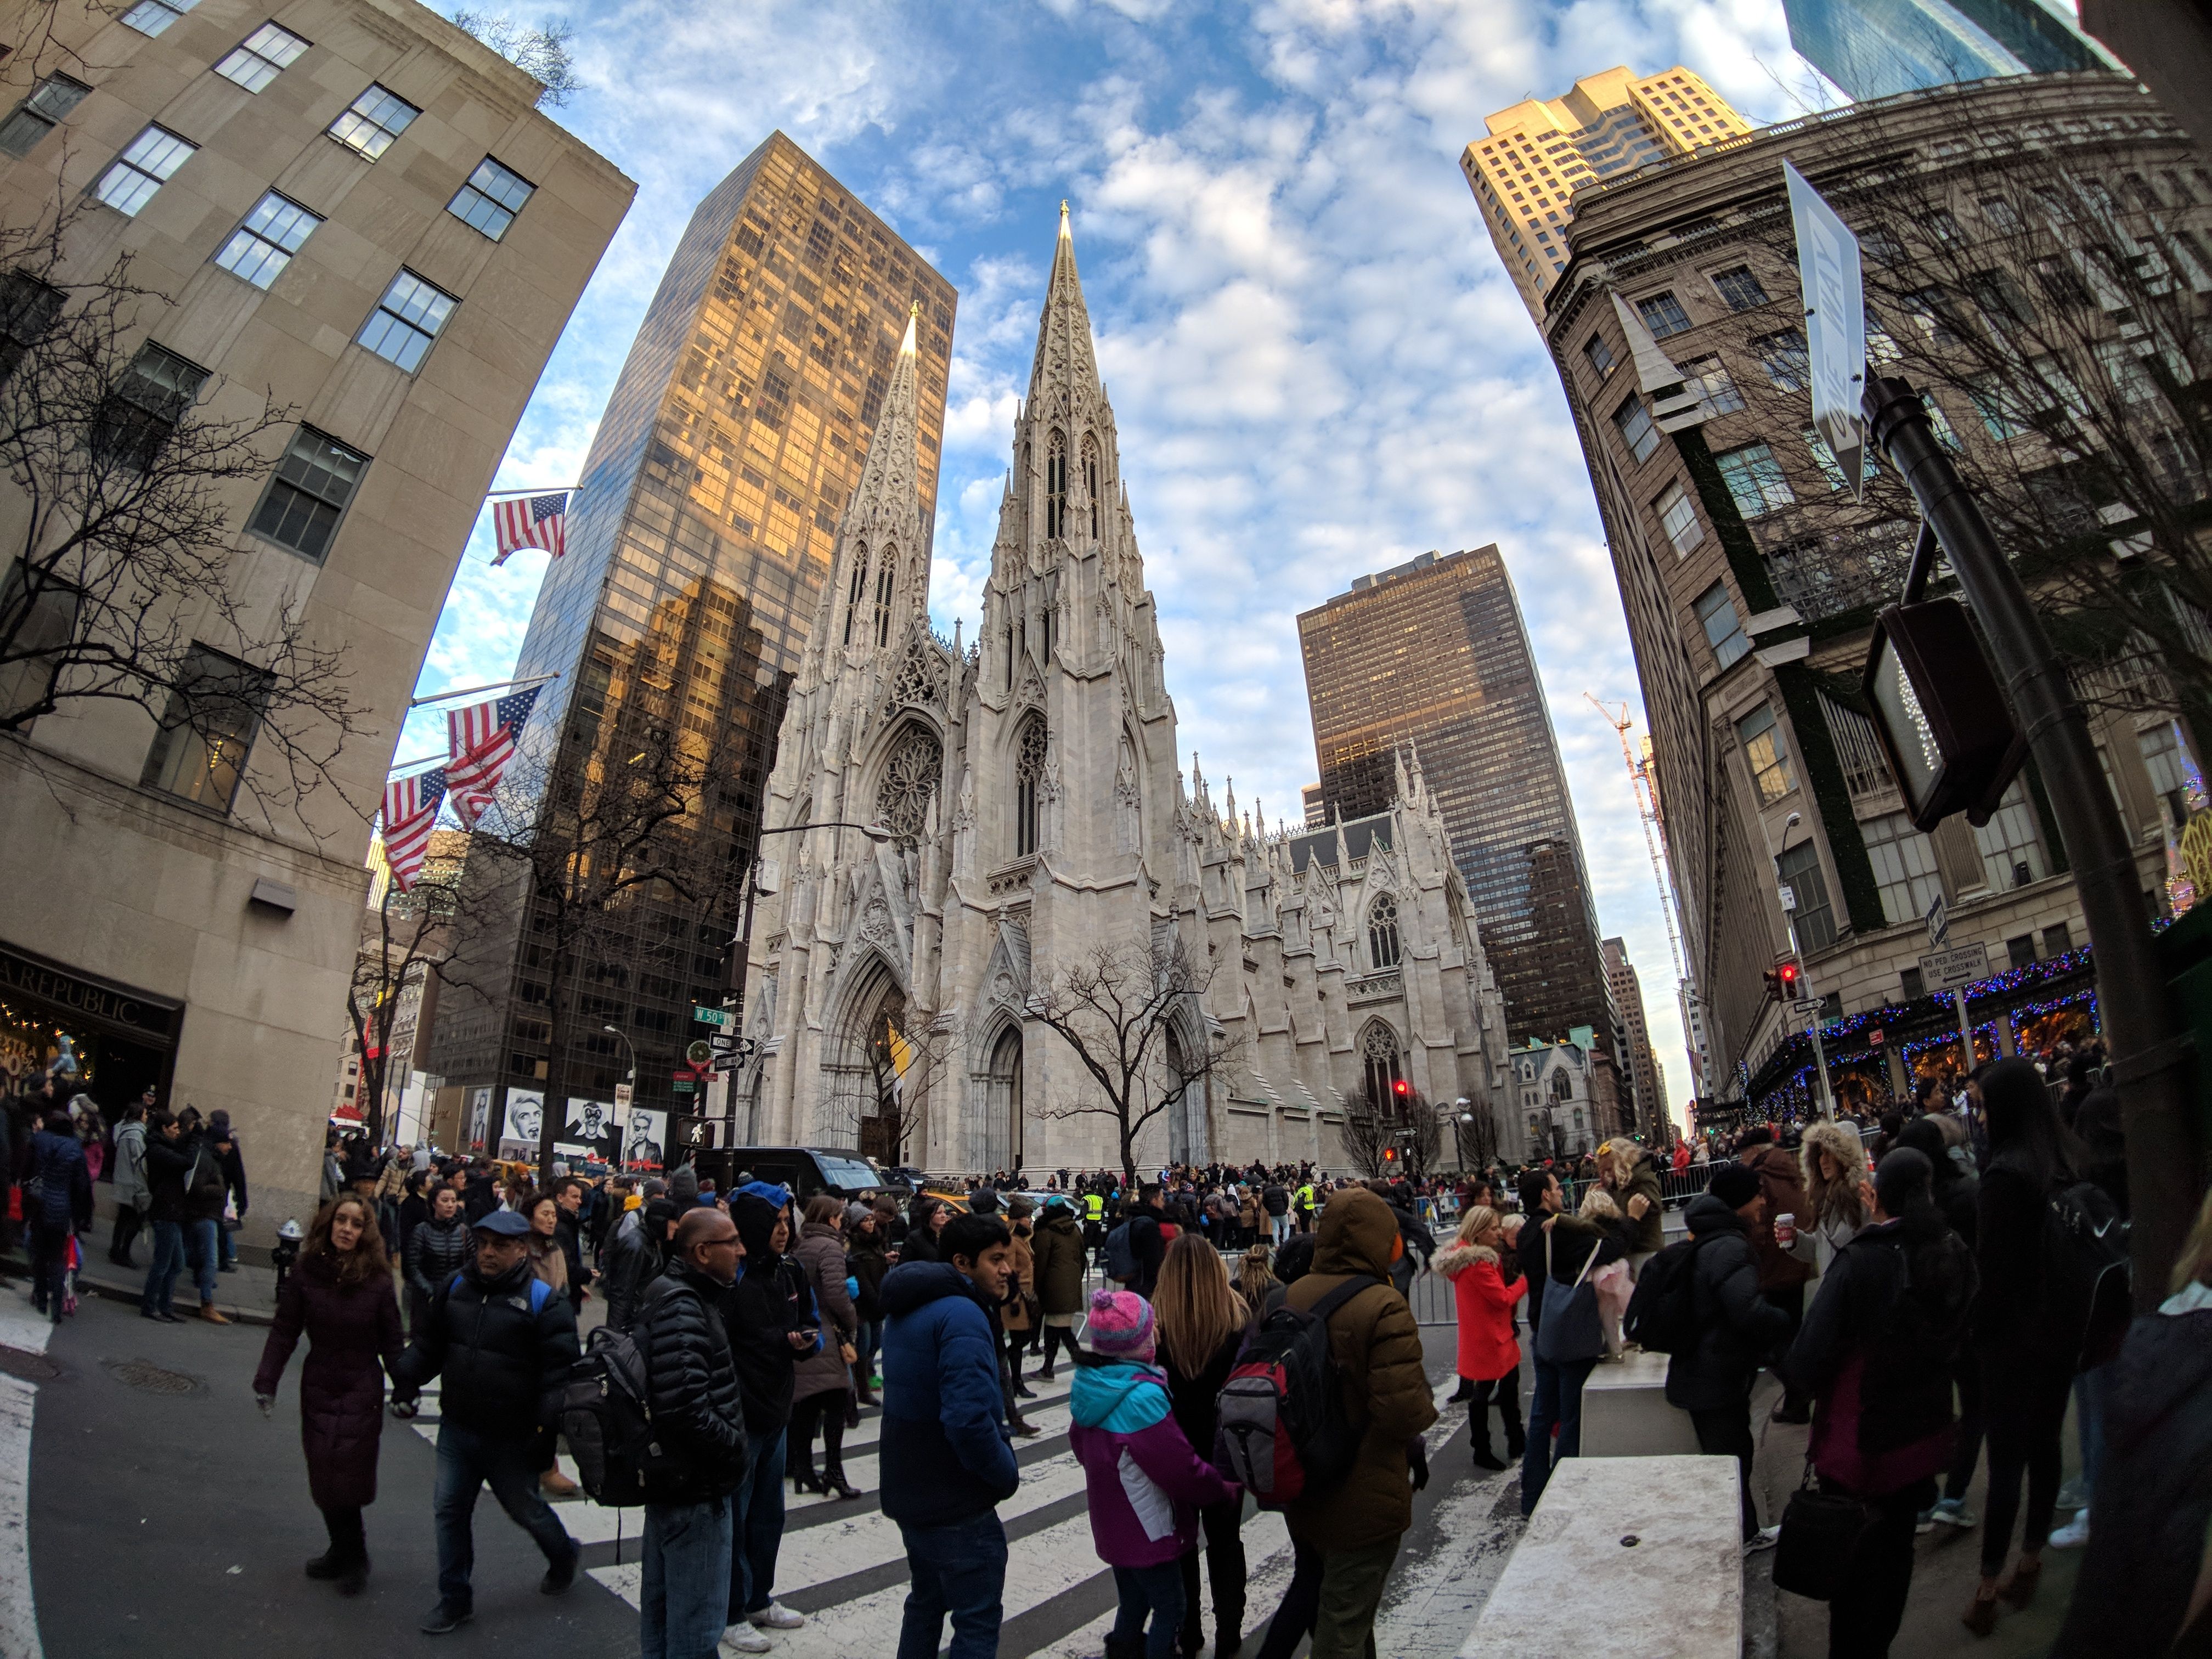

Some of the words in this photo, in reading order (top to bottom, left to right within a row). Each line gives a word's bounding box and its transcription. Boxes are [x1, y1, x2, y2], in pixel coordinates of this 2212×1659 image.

[1812, 225, 1845, 339] WAY
[1825, 354, 1848, 439] ONE
[1935, 957, 1948, 966] PED
[1950, 947, 1983, 961] CROSSING
[1928, 969, 1941, 978] USE
[1944, 959, 1982, 975] CROSSWALK
[20, 966, 139, 1024] REPUBLIC
[697, 1008, 704, 1020] W
[707, 1011, 718, 1022] 50
[716, 1039, 730, 1047] ONE
